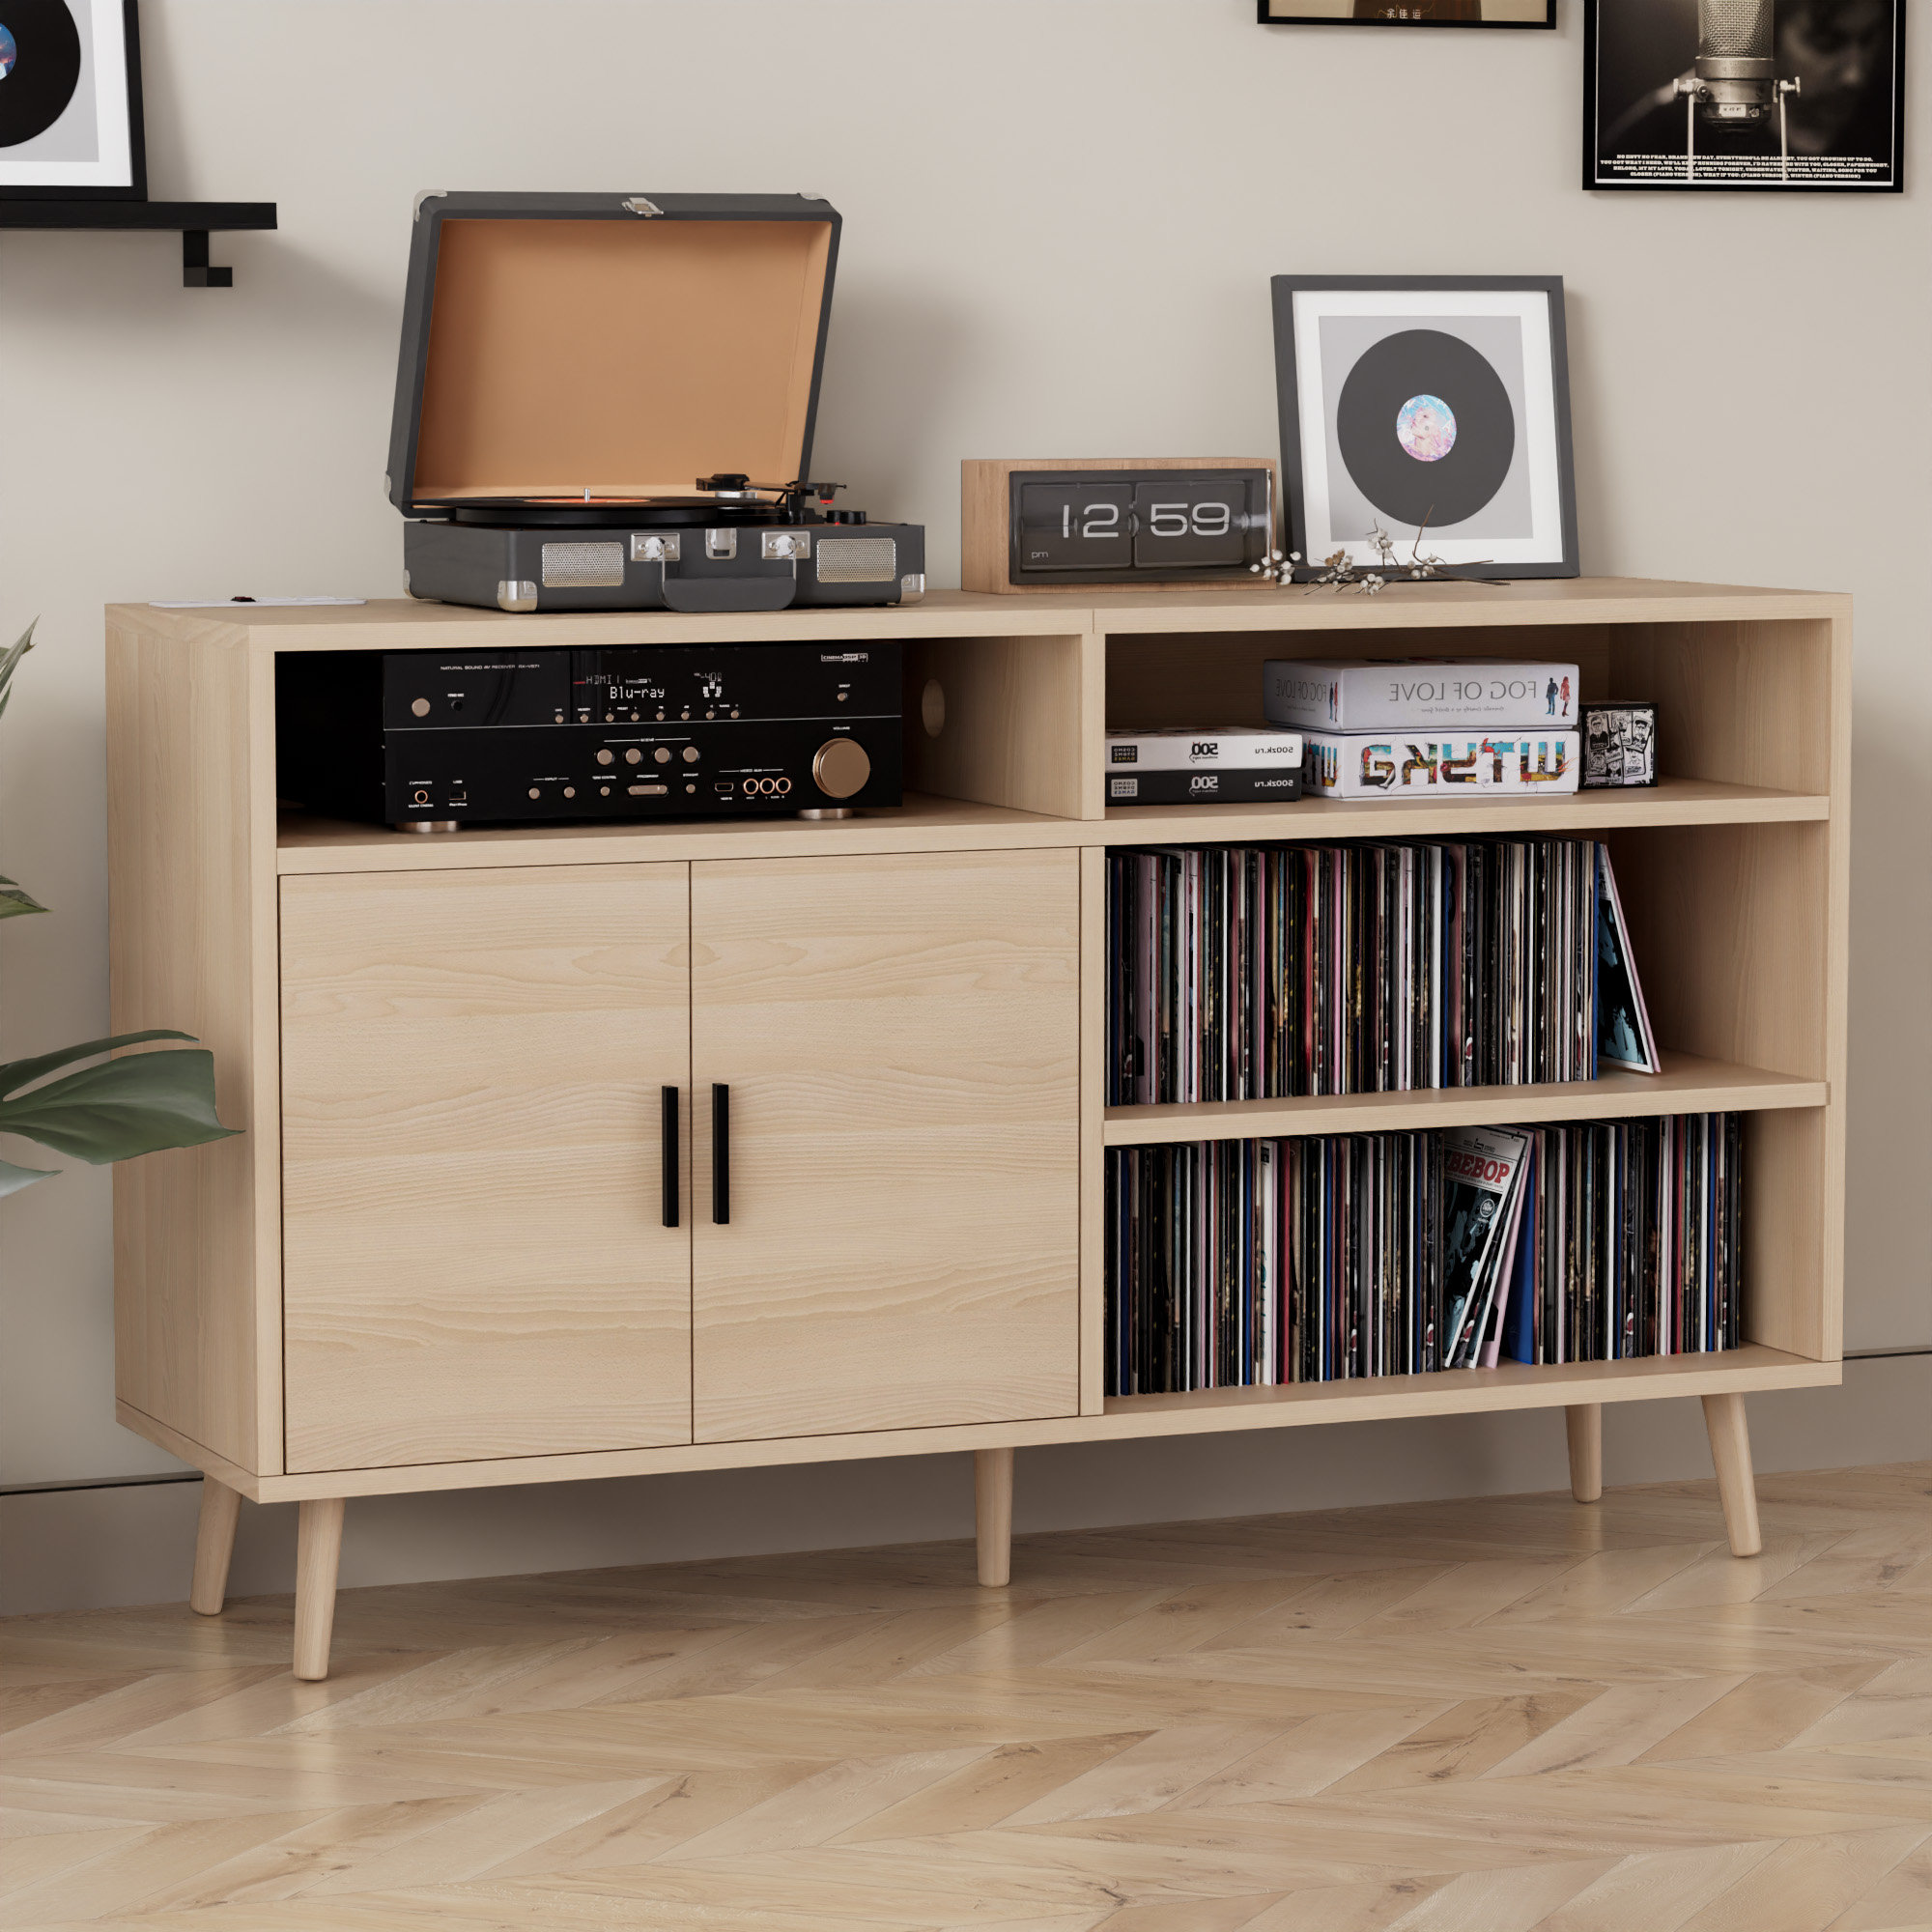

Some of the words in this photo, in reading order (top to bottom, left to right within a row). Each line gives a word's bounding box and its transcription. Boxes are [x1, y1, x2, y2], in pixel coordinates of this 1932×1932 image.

[1063, 504, 1119, 538] 12
[1150, 502, 1230, 537] 59
[586, 675, 612, 684] HDMI
[610, 686, 665, 699] Blu-ray
[1447, 1151, 1510, 1184] BEBOP
